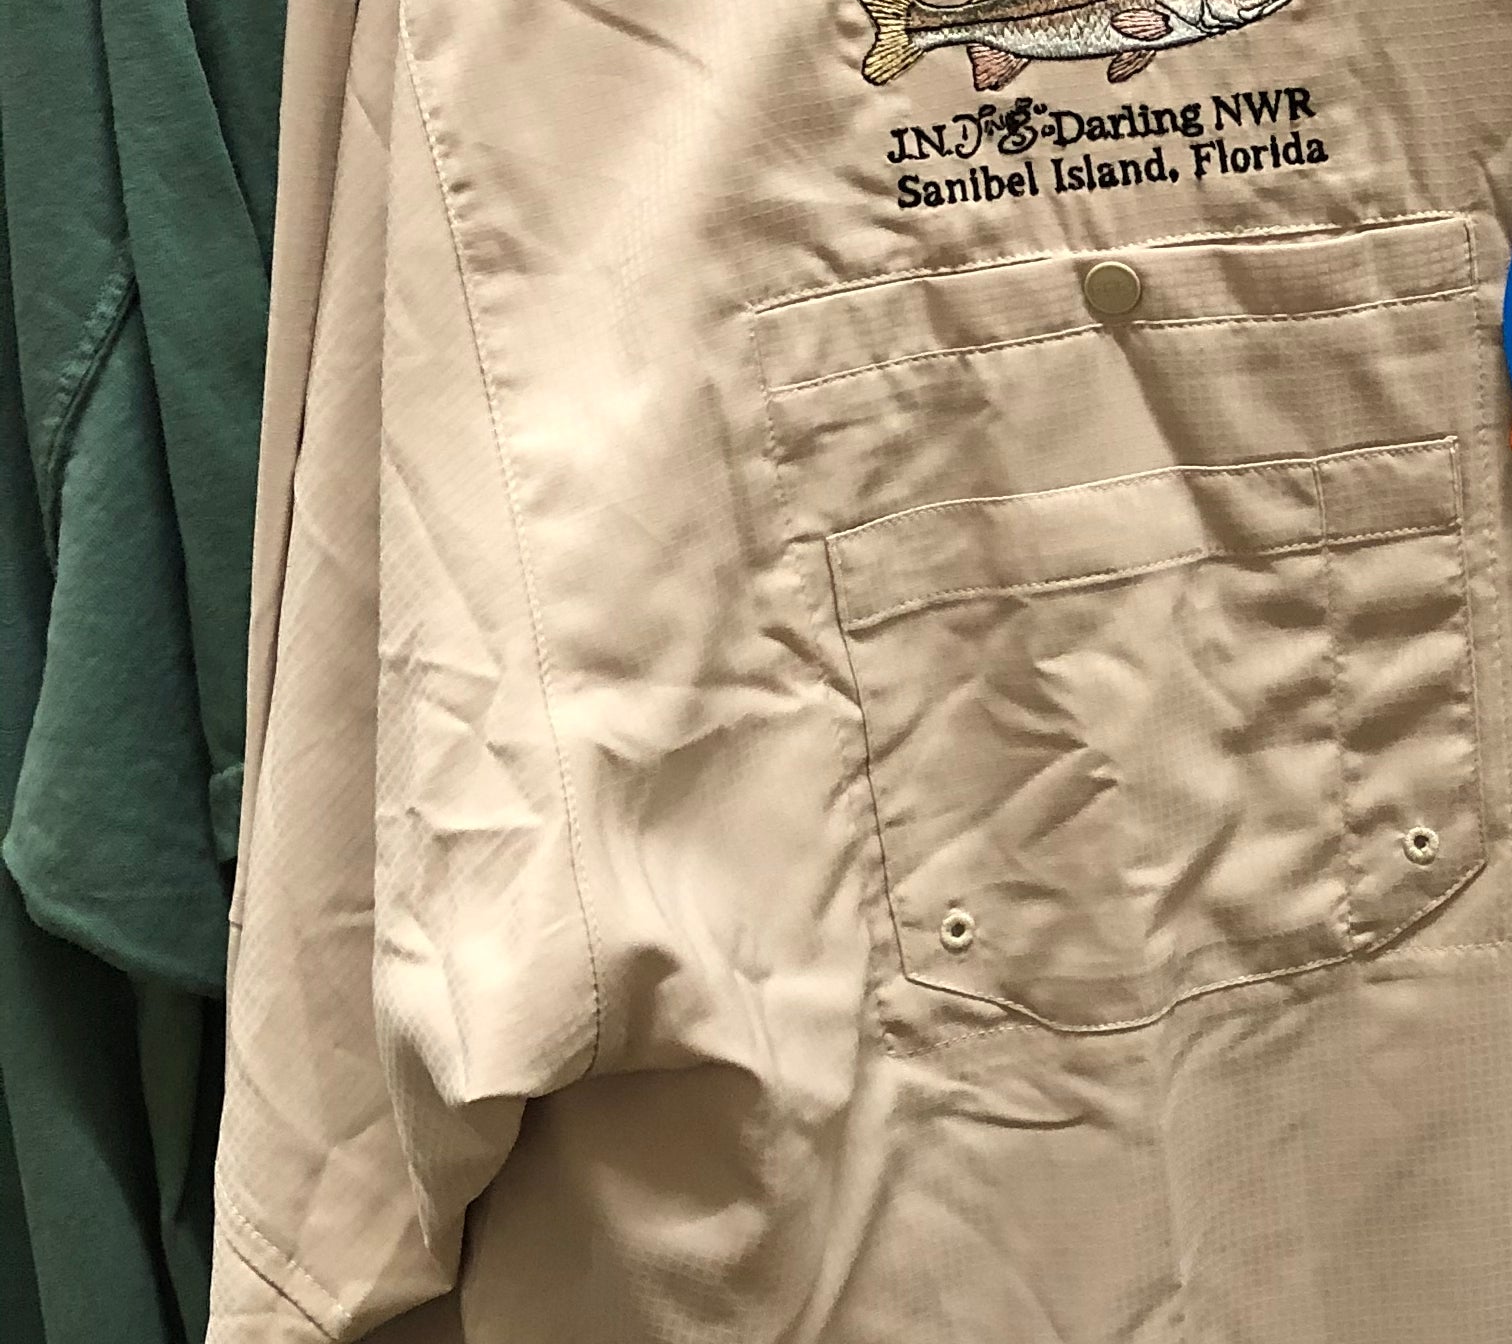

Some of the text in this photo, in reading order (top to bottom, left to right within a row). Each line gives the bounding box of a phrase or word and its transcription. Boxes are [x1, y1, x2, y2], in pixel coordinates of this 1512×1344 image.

[1049, 100, 1203, 146] Darling
[1212, 87, 1317, 132] NWR
[897, 133, 1328, 208] Sanibel Island, Florida
